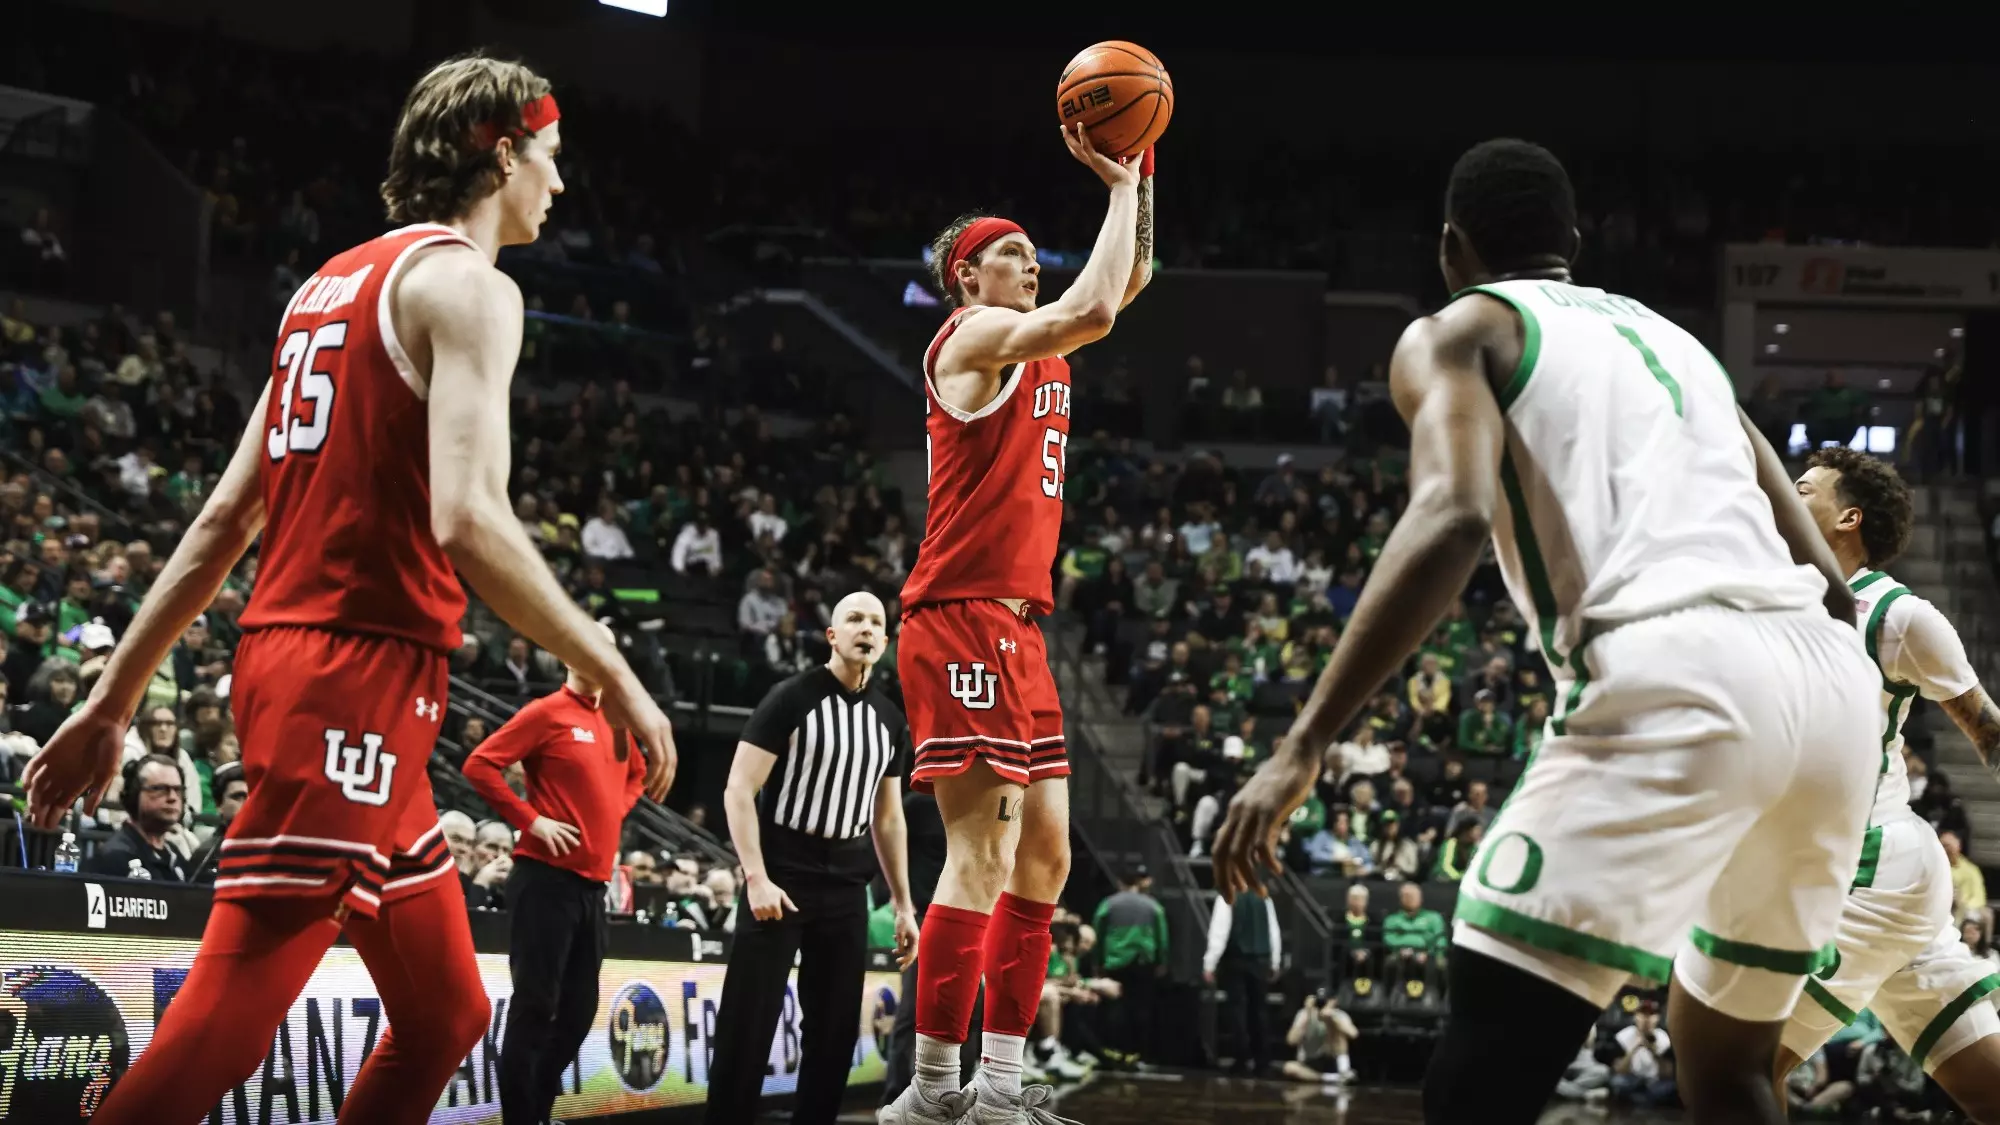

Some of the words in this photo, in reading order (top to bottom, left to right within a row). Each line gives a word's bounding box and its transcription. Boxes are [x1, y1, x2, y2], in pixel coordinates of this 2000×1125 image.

[268, 320, 348, 462] 35
[1032, 380, 1071, 421] UTA
[1612, 322, 1684, 418] 1
[108, 896, 168, 920] LEARFIELD
